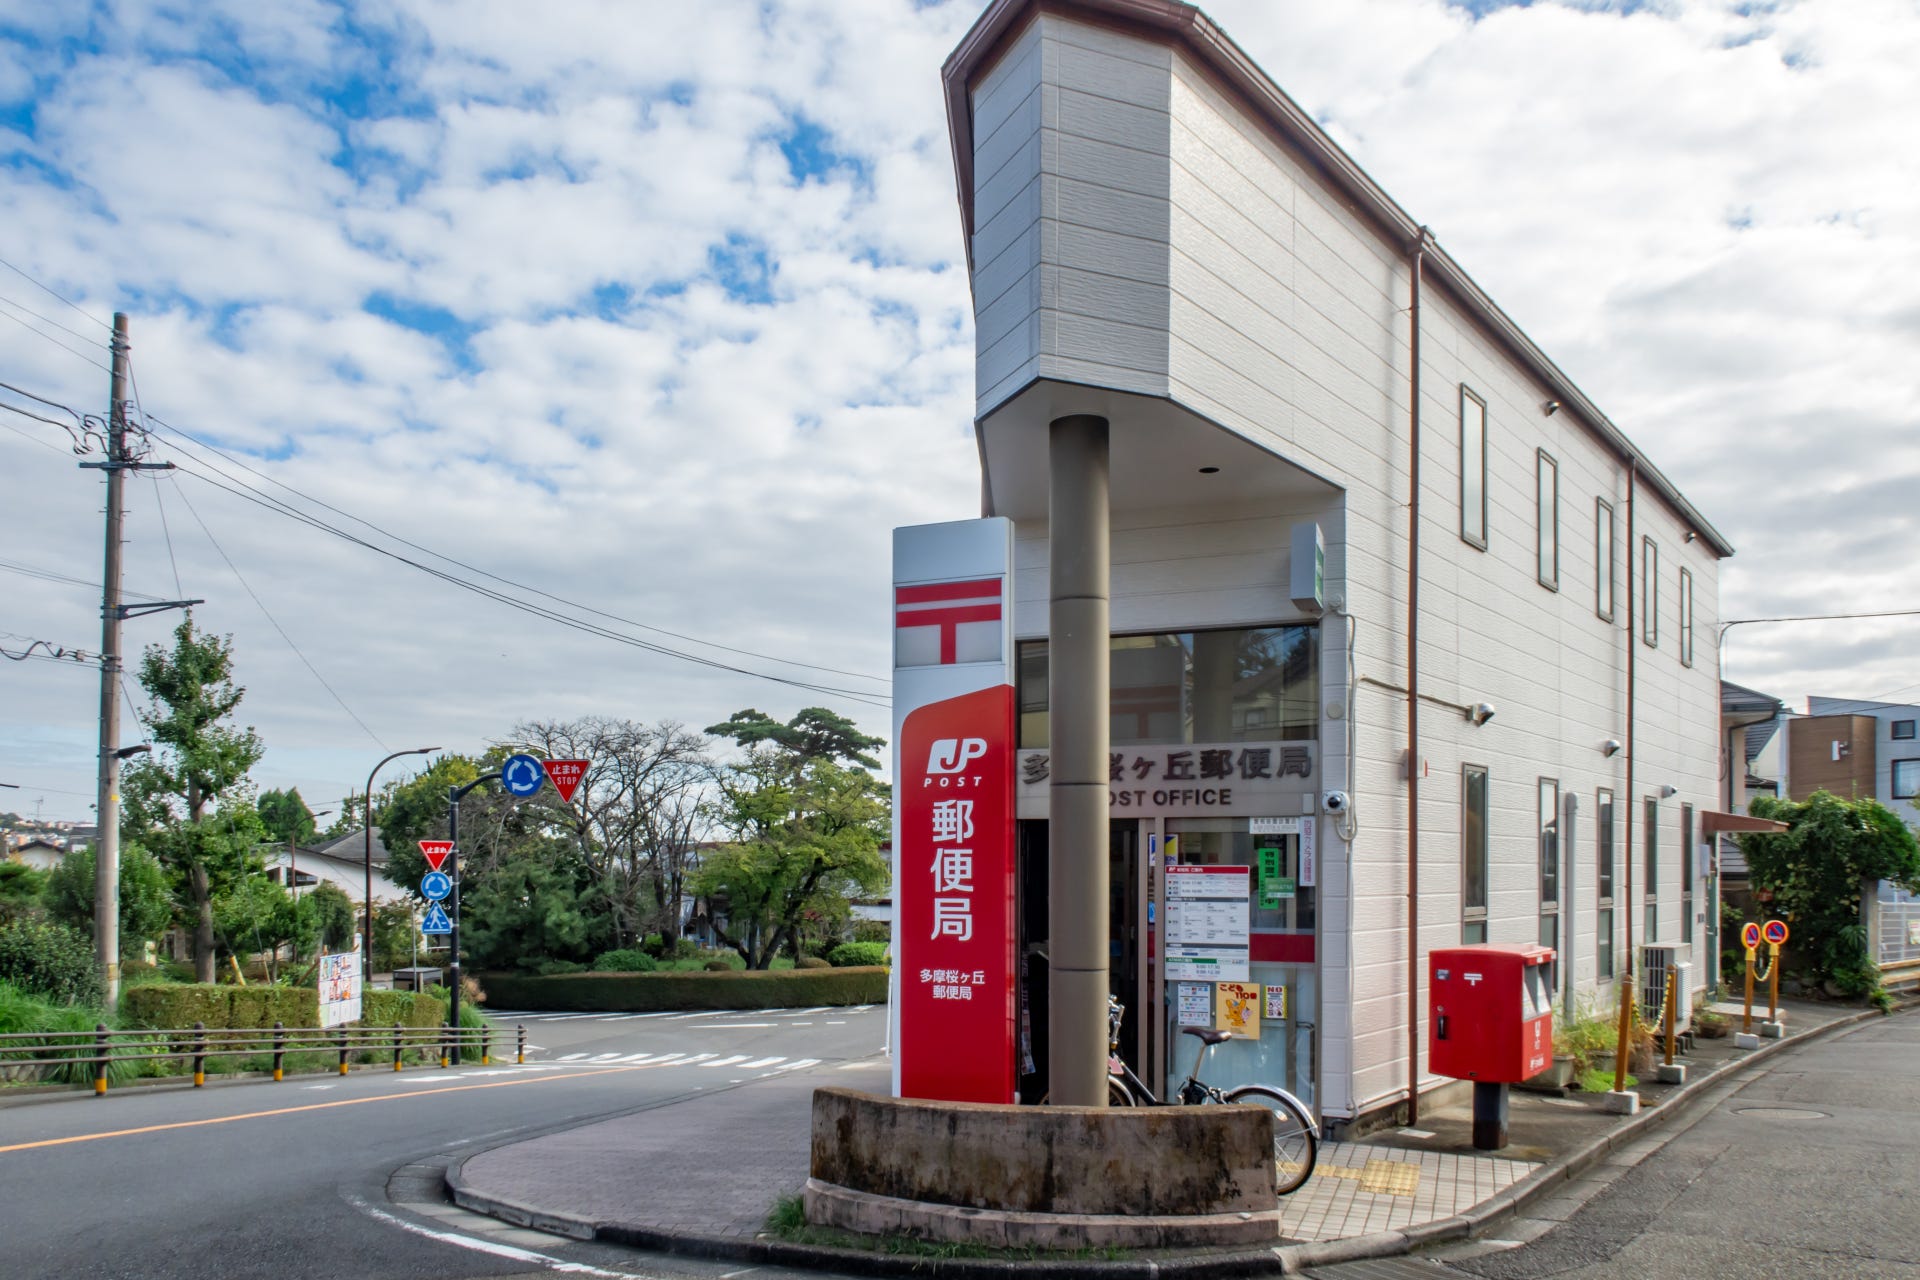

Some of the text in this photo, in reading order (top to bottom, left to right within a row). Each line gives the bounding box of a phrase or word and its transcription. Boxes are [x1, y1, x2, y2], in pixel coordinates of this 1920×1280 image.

[927, 738, 988, 774] JP
[551, 764, 581, 775] 止まれ
[556, 776, 577, 785] STOP
[923, 776, 982, 788] POST
[1152, 788, 1232, 807] OFFICE
[930, 799, 974, 941] 郵便局
[920, 968, 985, 985] 多摩桜ヶ丘
[932, 984, 972, 1001] 郵便局
[1220, 983, 1244, 992] こども
